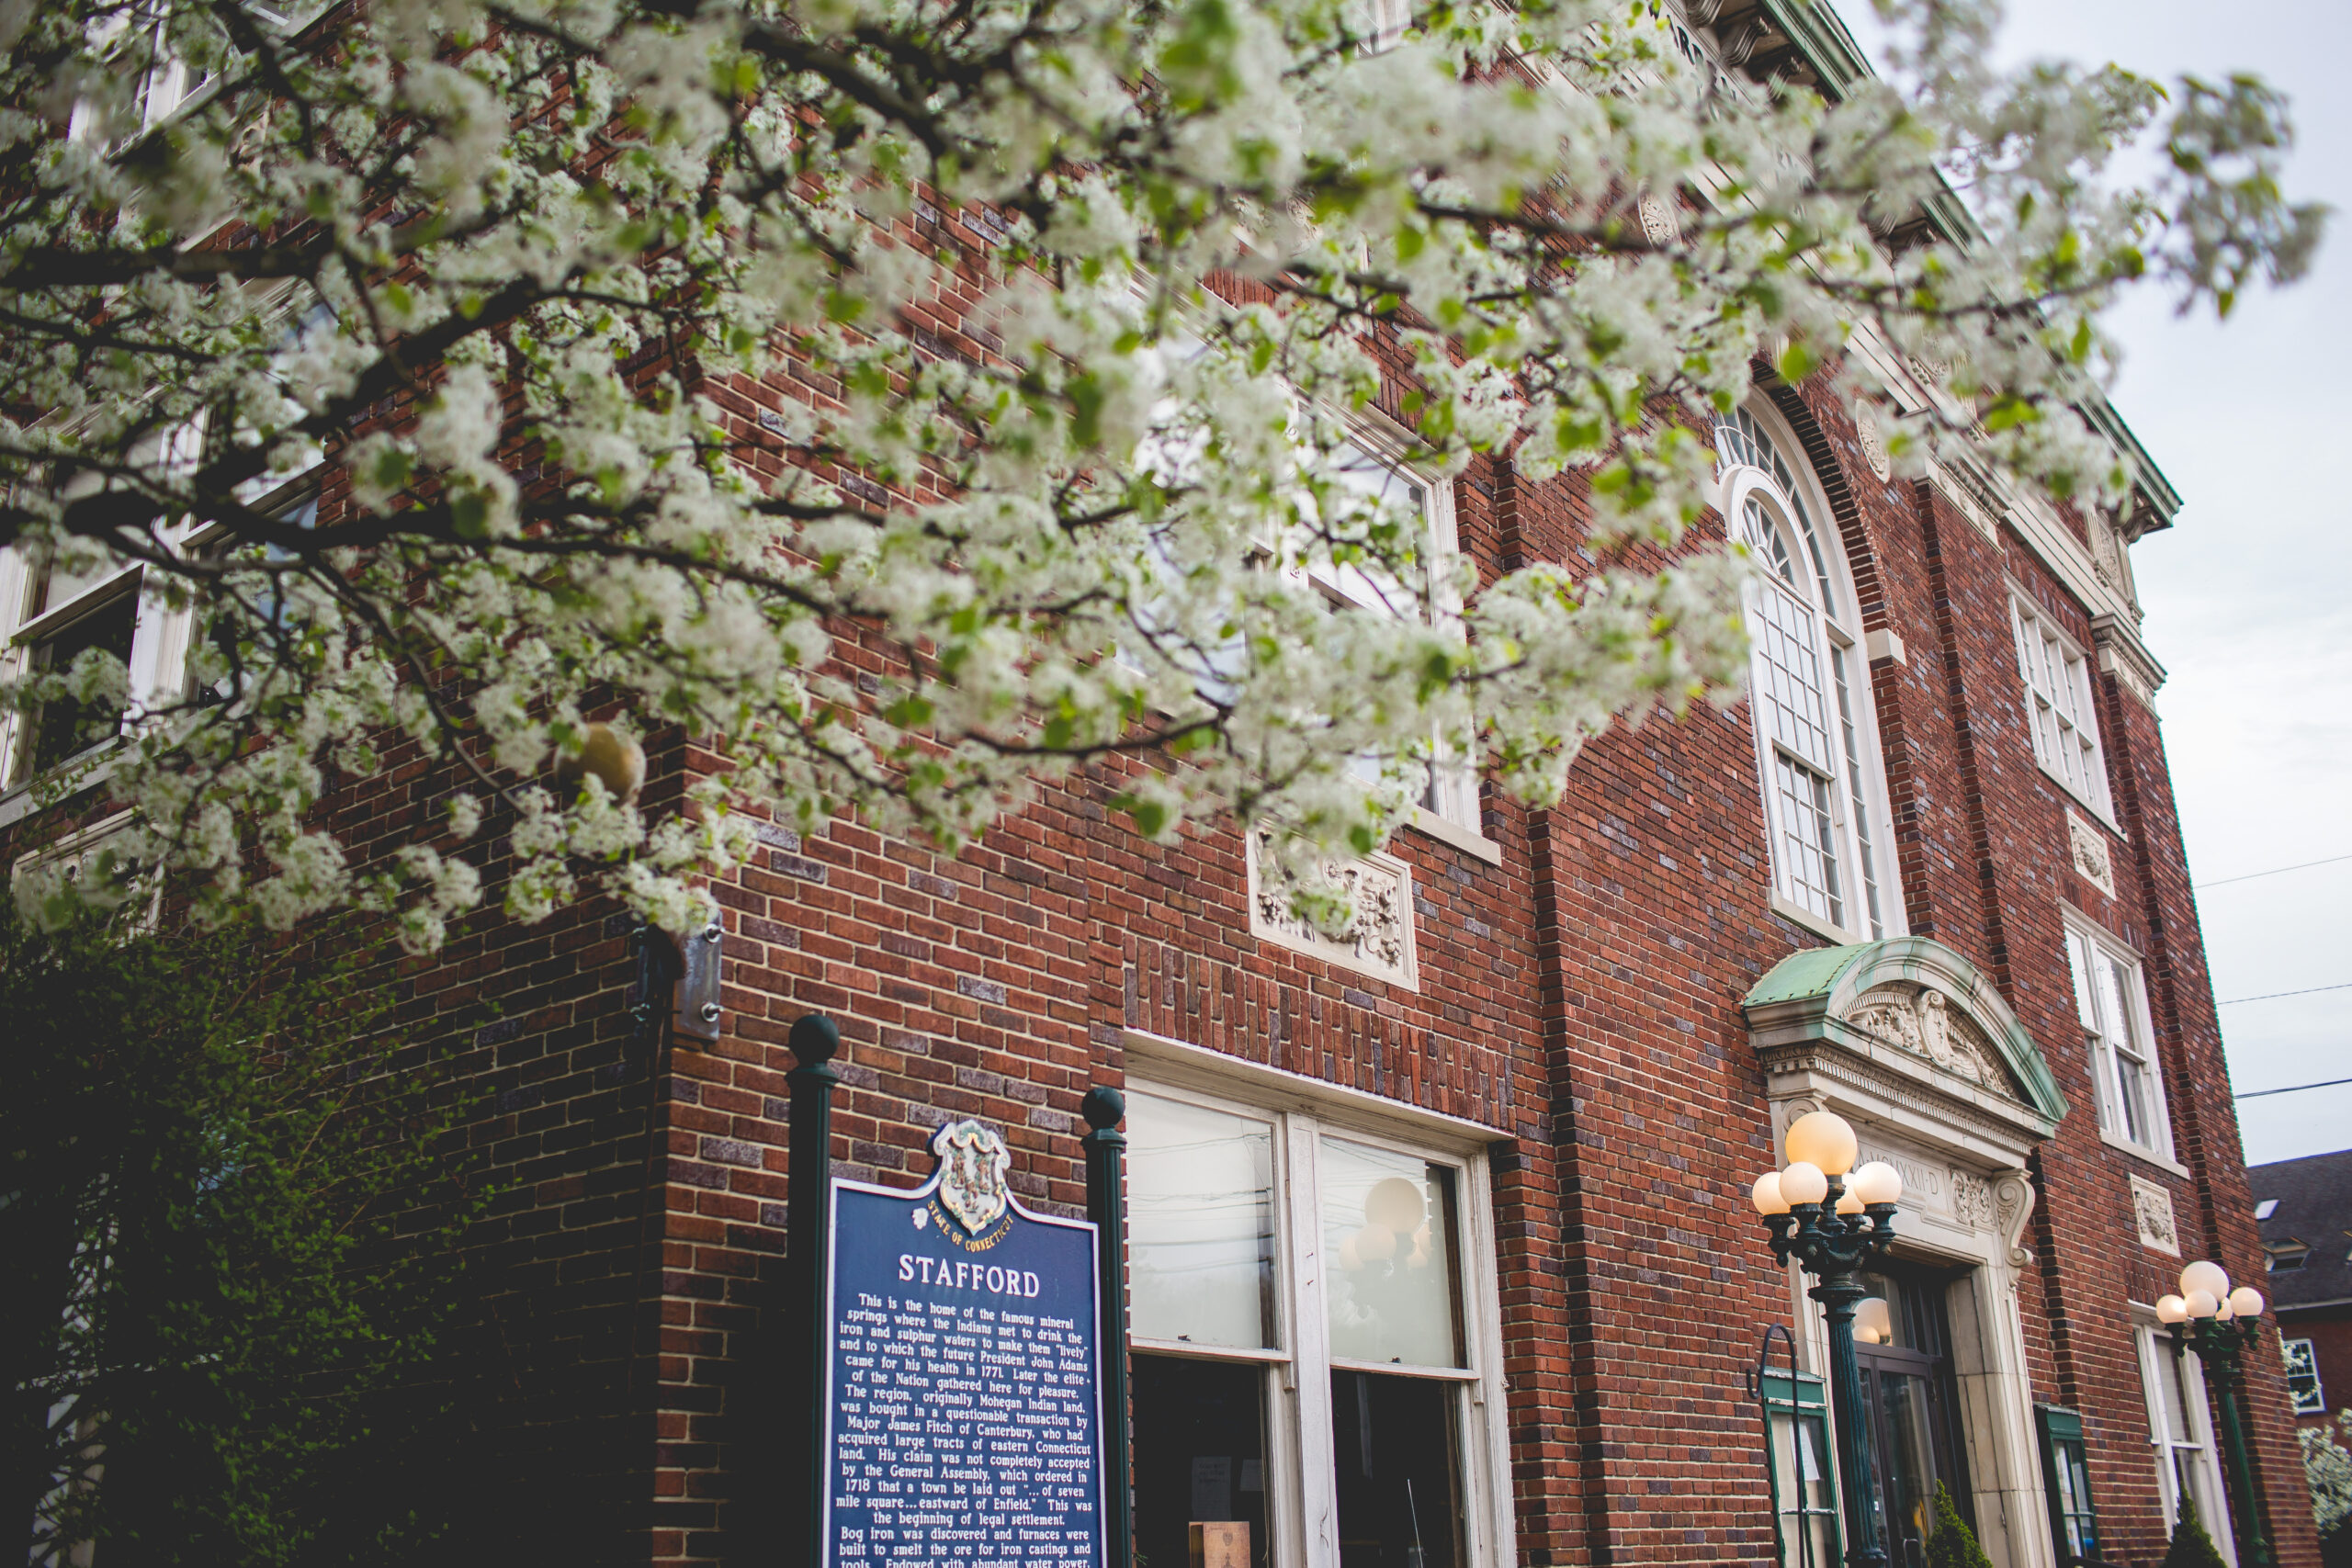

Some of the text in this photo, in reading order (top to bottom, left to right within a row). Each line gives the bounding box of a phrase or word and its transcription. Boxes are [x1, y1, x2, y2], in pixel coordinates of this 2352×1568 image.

[927, 1200, 1014, 1253] STATE OF CONNECTICUT
[899, 1254, 1040, 1298] STAFFORD
[858, 1292, 1074, 1330] This is the home of the famous mineral
[840, 1321, 863, 1336] iron
[870, 1326, 890, 1339] and
[897, 1328, 936, 1344] sulphur
[944, 1335, 976, 1348] waters
[982, 1337, 992, 1349] to
[998, 1339, 1023, 1352] make
[1028, 1342, 1051, 1355] them
[847, 1308, 1082, 1345] springs where the Indians met to drink the
[839, 1338, 1088, 1372] and to which the future President John Adams
[845, 1355, 1084, 1386] came for his health in 1771. Later the elite
[852, 1370, 1079, 1399] of the Nation gathered here for pleasure.
[844, 1383, 866, 1398] The
[922, 1390, 973, 1408] originally
[979, 1393, 1023, 1412] Mohegan
[1028, 1397, 1057, 1412] Indian
[1063, 1401, 1085, 1414] land.
[841, 1402, 1088, 1430] was bought in a questionable transaction by
[847, 1415, 880, 1432] Major
[888, 1419, 921, 1432] James
[926, 1419, 953, 1434] Fitch
[959, 1423, 970, 1435] of
[1042, 1427, 1061, 1440] who
[1067, 1429, 1083, 1441] had
[838, 1431, 1091, 1456] acquired large tracts of eastern Connecticut
[839, 1447, 1091, 1472] land. His claim was not completely accepted
[842, 1462, 855, 1478] by
[865, 1464, 883, 1477] the
[889, 1464, 933, 1479] General
[999, 1469, 1028, 1482] which
[1035, 1471, 1073, 1483] ordered
[1078, 1471, 1087, 1483] in
[845, 1478, 870, 1493] 1718
[877, 1480, 900, 1493] that
[907, 1483, 914, 1494] a
[921, 1482, 947, 1495] town
[954, 1482, 967, 1495] be
[972, 1483, 993, 1495] laid
[1000, 1484, 1016, 1496] out
[1057, 1487, 1084, 1497] seven
[836, 1495, 860, 1508] mile
[975, 1497, 987, 1510] of
[1047, 1498, 1069, 1512] This
[1075, 1502, 1092, 1512] was
[873, 1511, 1065, 1529] the beginning of legal settlement.
[841, 1526, 1089, 1544] Bog iron was discovered and furnaces were
[839, 1542, 1091, 1559] built to smelt the ore for iron castings and
